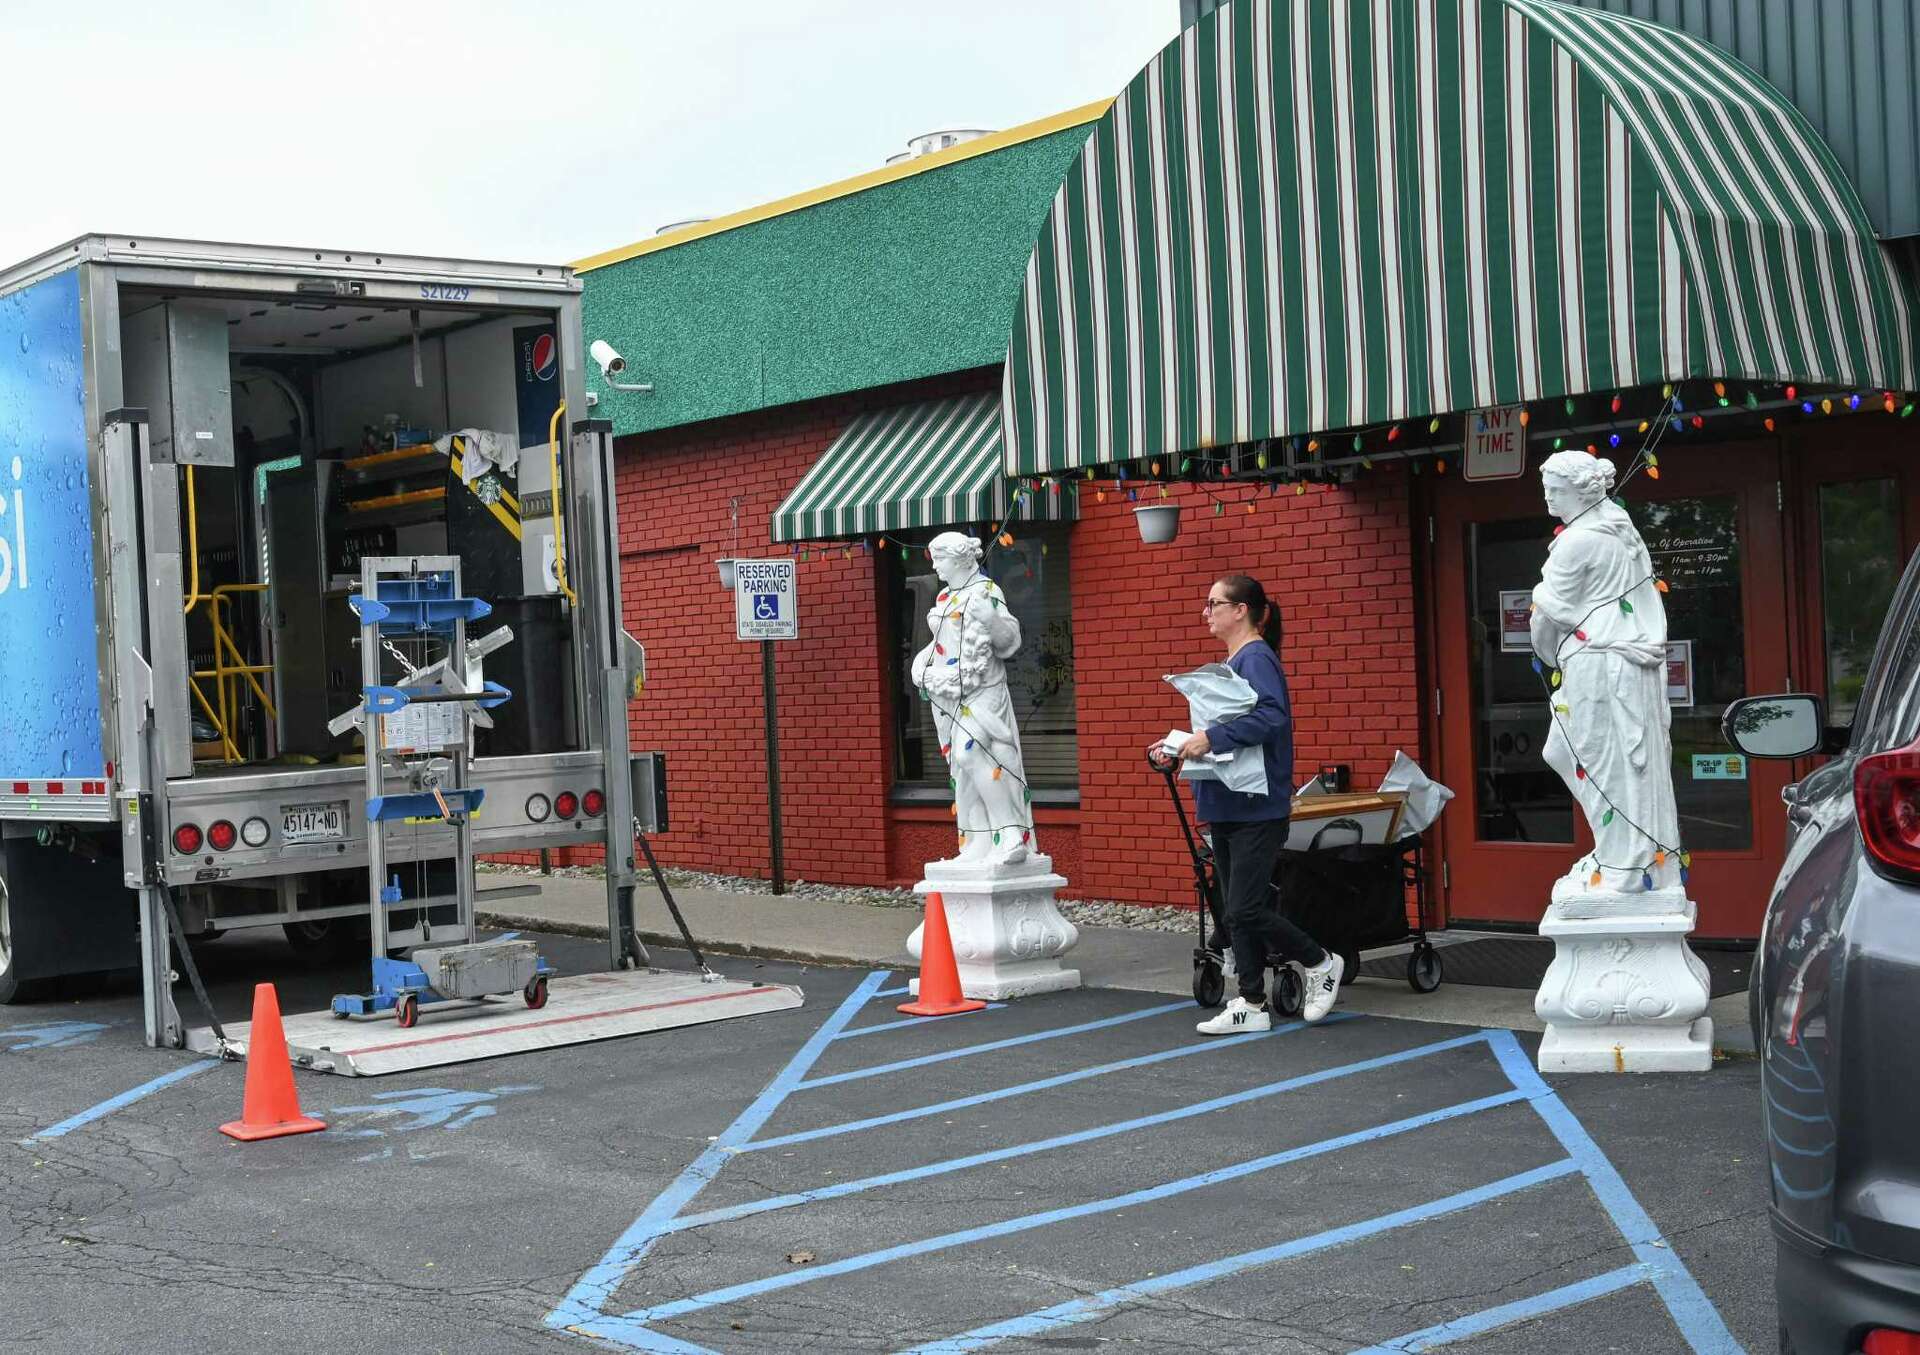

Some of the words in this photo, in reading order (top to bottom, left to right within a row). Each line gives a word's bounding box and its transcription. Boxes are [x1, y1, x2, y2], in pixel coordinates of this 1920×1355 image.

[421, 283, 470, 301] S21229
[1476, 432, 1514, 455] TIME
[1660, 538, 1671, 550] Of
[1673, 536, 1714, 549] Operation
[738, 564, 791, 579] RESERVED
[743, 579, 787, 593] PARKING
[1232, 1011, 1247, 1025] NY
